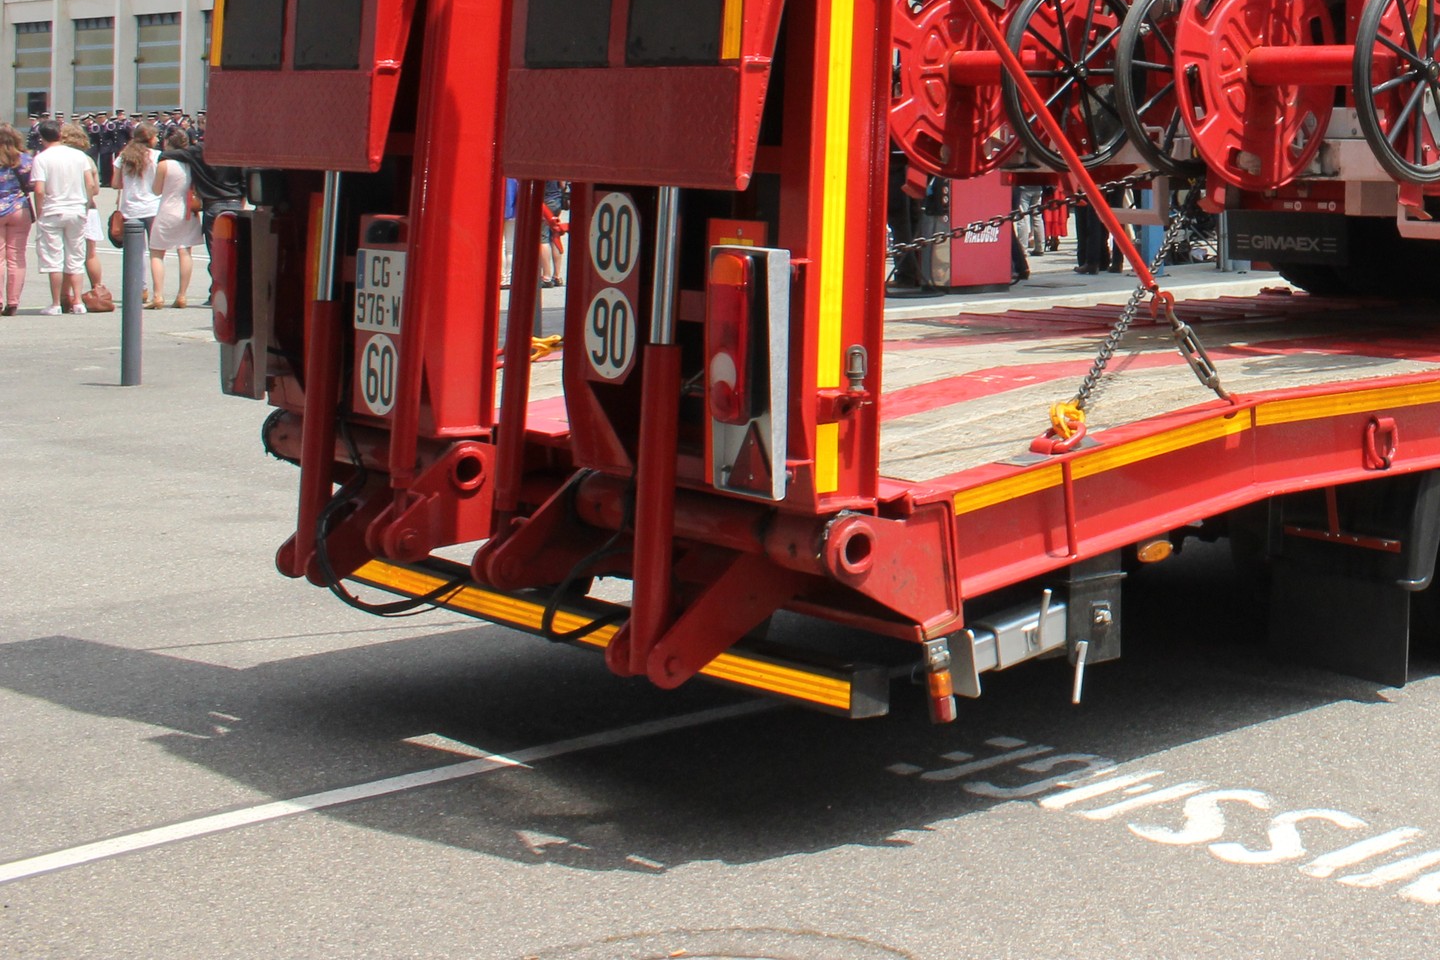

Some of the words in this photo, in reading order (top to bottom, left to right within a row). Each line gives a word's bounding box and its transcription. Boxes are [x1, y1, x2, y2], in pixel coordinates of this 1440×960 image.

[596, 202, 633, 274] 80
[1251, 234, 1321, 253] GIMAEX
[592, 297, 628, 369] 90
[365, 342, 394, 407] 60
